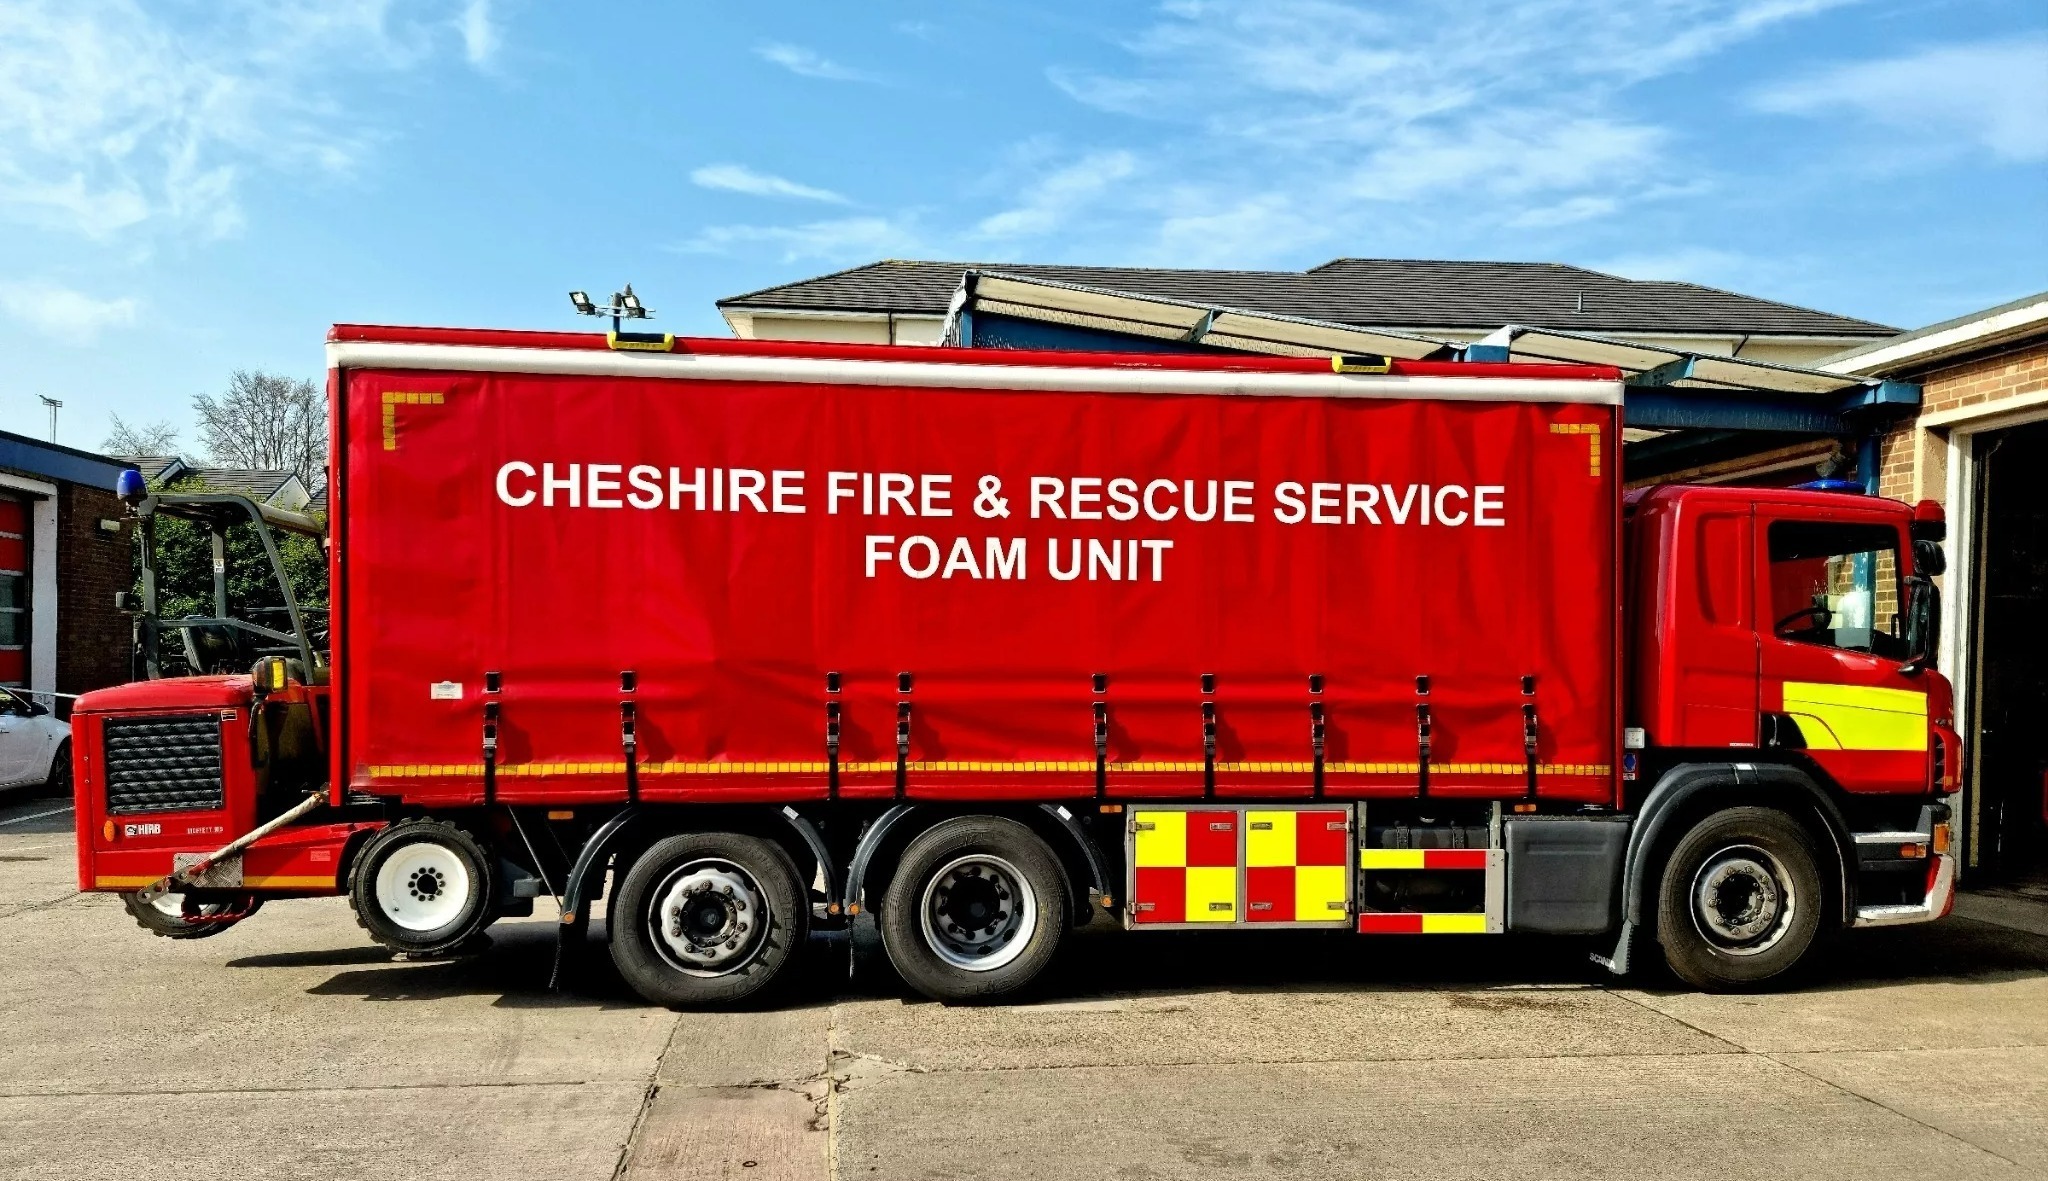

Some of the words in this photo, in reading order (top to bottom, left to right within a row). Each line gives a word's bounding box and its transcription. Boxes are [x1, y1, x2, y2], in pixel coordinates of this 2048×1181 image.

[495, 460, 806, 514] CHESHIRE
[827, 471, 953, 517] FIRE
[973, 474, 1011, 519] &
[1030, 476, 1255, 523] RESCUE
[1273, 481, 1505, 527] SERVICE
[865, 534, 1027, 580] FOAM
[1048, 537, 1174, 582] UNIT
